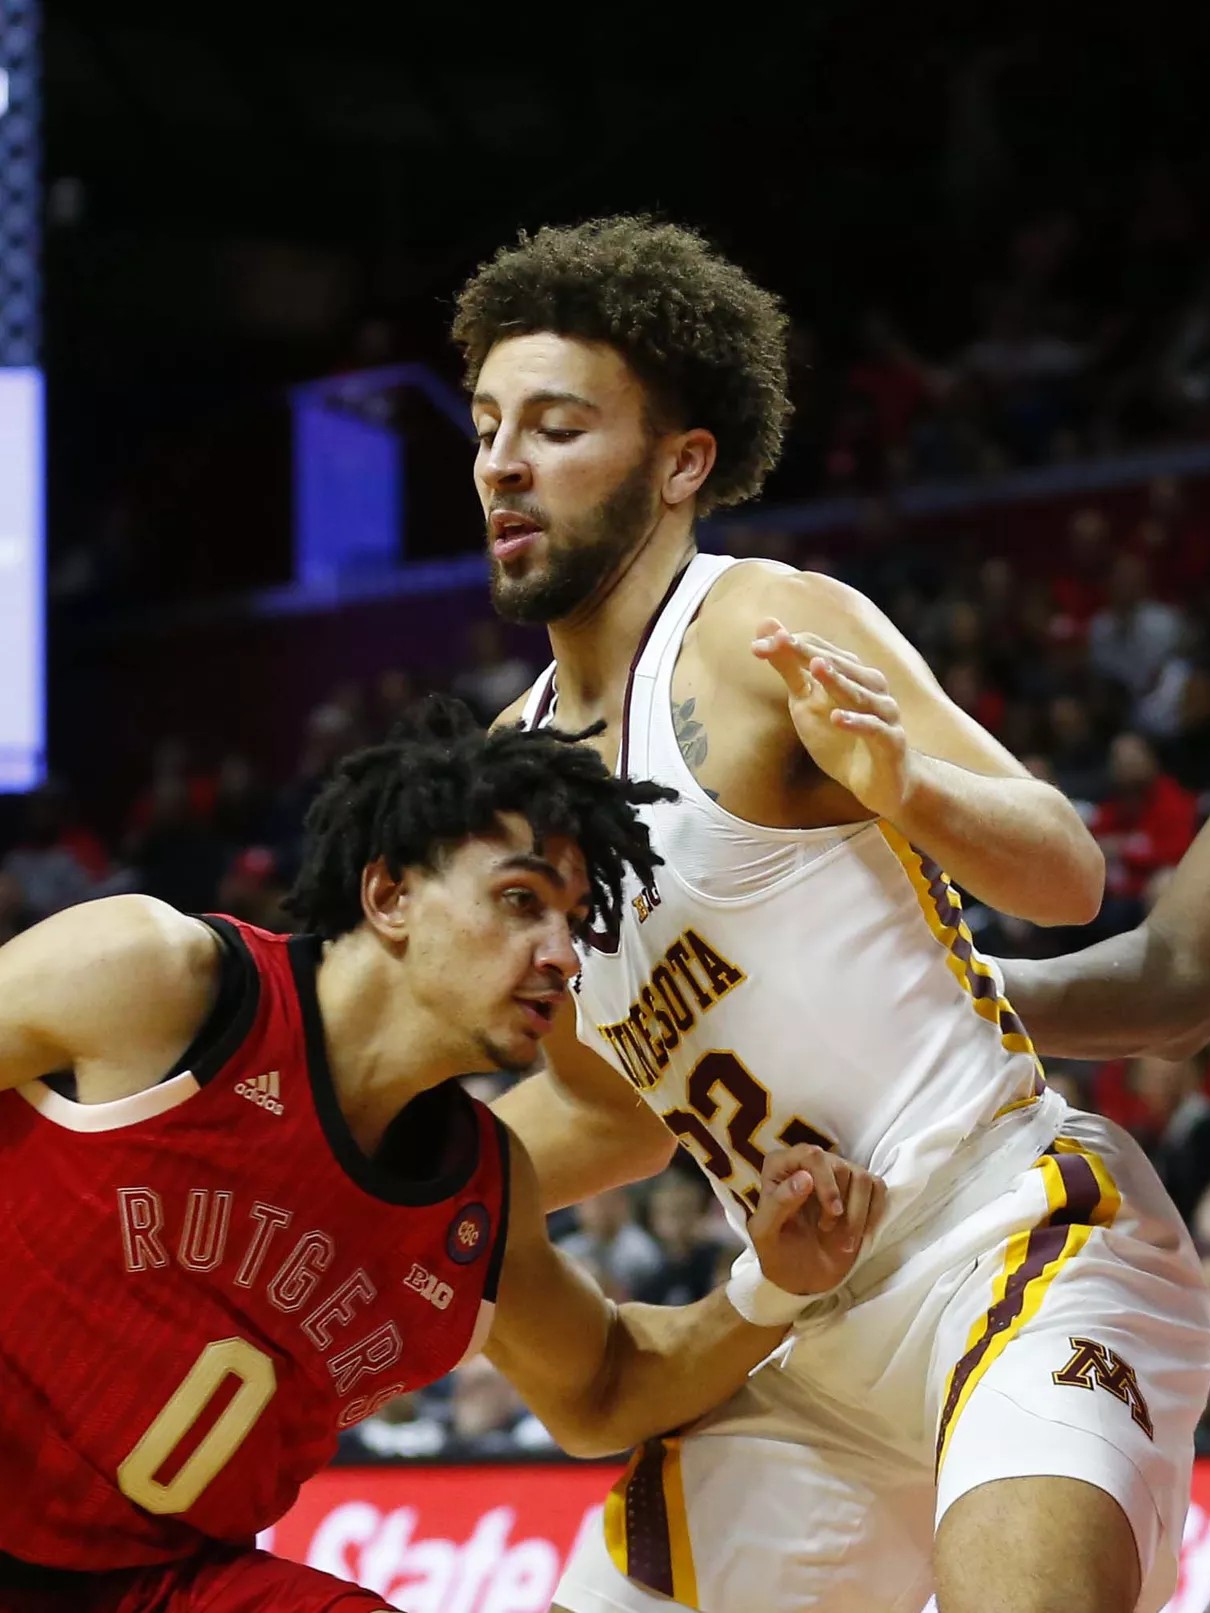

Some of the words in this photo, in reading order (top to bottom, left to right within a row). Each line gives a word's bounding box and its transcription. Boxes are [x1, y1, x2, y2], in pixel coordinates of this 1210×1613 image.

[234, 1082, 284, 1116] adidas
[117, 1336, 278, 1515] 0
[304, 1500, 561, 1613] State
